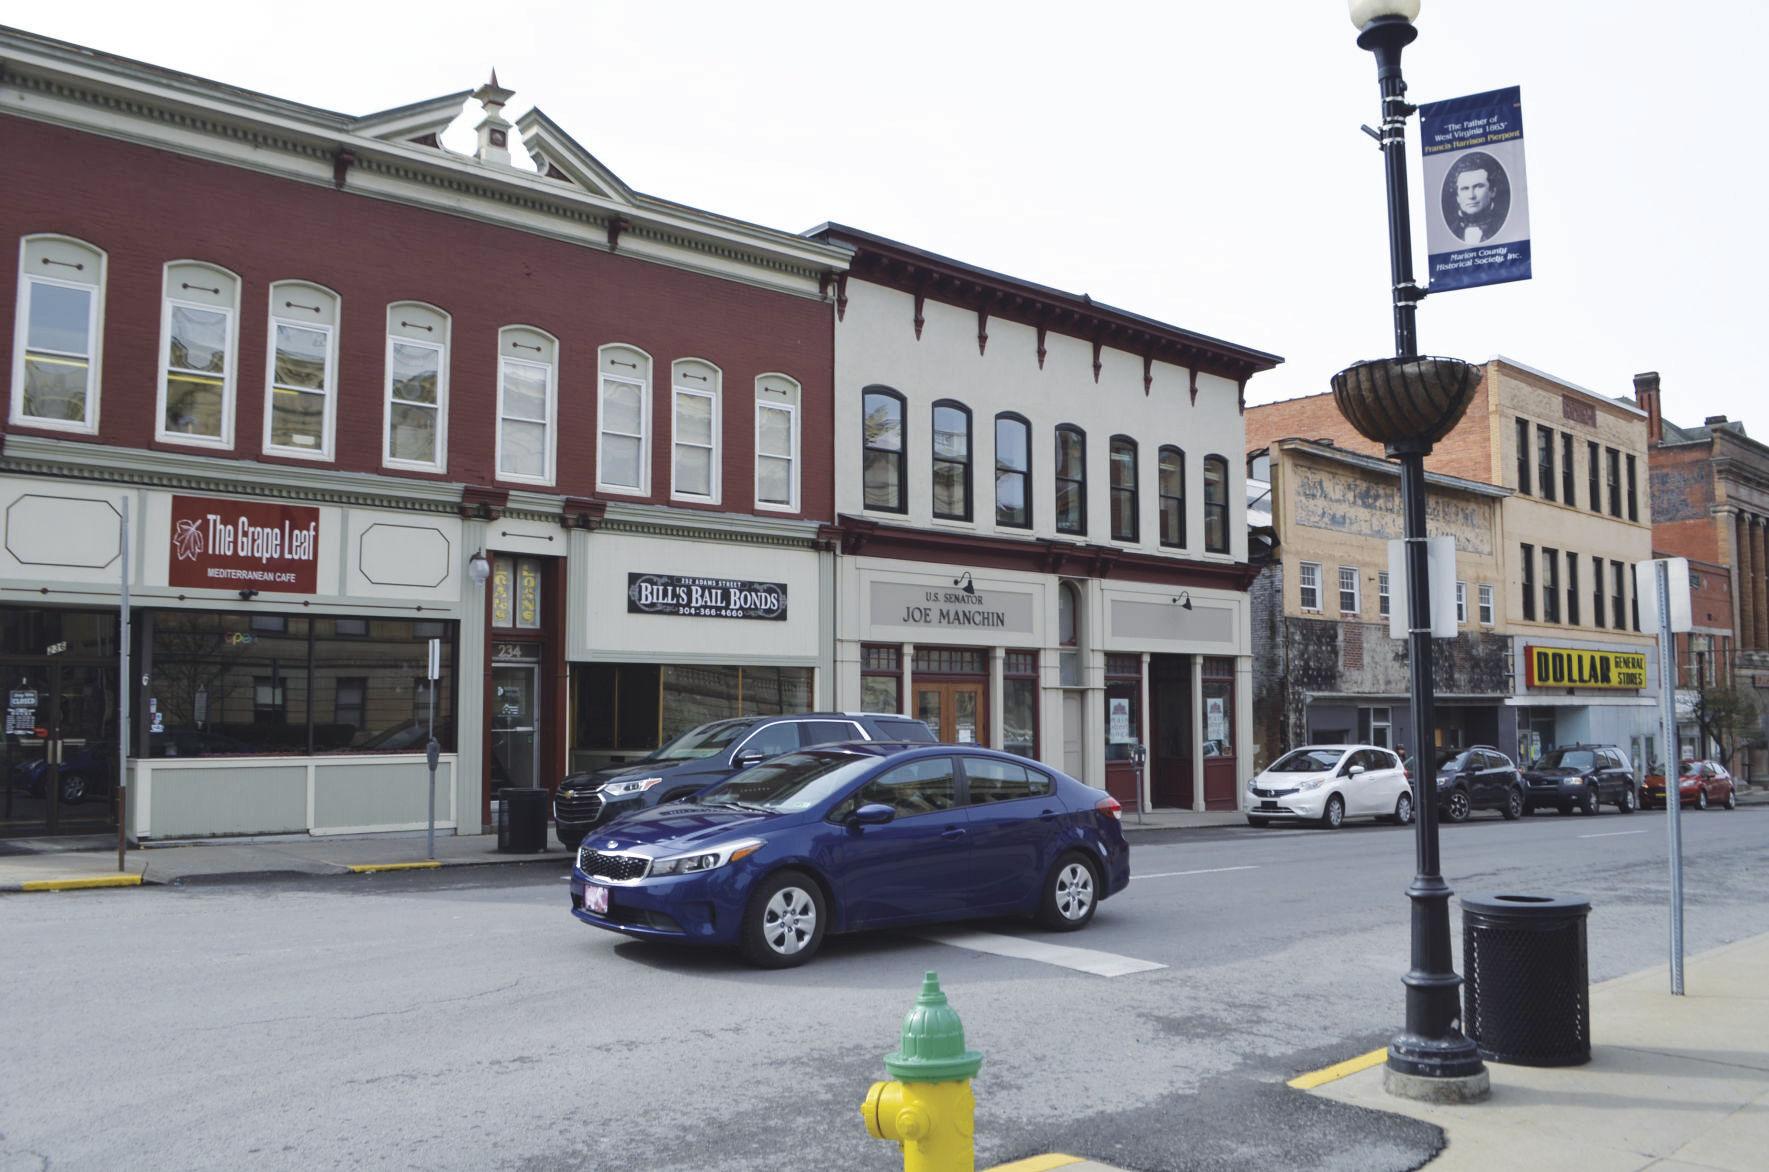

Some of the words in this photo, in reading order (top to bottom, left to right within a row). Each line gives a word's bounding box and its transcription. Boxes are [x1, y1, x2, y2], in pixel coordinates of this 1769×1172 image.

[1463, 118, 1487, 129] Father
[1489, 115, 1498, 123] of
[1424, 142, 1452, 153] Francis
[1453, 136, 1486, 148] Harrison
[1487, 130, 1520, 142] Pierpont
[1434, 133, 1452, 142] West
[1454, 126, 1483, 138] Virginia
[1436, 258, 1473, 272] Historical
[1473, 254, 1505, 265] Society,
[1507, 252, 1522, 261] Inc.
[1450, 250, 1477, 261] Marion
[1478, 247, 1508, 257] County
[207, 513, 234, 556] The
[237, 516, 281, 564] Grape
[284, 519, 316, 561] Leaf
[207, 567, 274, 582] MEDITERRANEAN
[275, 572, 296, 583] CAFE
[695, 578, 717, 587] ADAMS
[718, 579, 741, 589] STREET
[639, 582, 688, 605] BILL'S
[690, 585, 726, 608] BAIL
[729, 588, 779, 610] BONDS
[925, 591, 940, 602] U.S.
[943, 592, 984, 605] SENATOR
[678, 606, 743, 618] 304-366-4660
[903, 606, 932, 624] JOE
[938, 608, 1005, 627] MANCHIN
[497, 644, 522, 658] 234
[1536, 651, 1612, 684] DOLLAR
[1614, 655, 1644, 670] GENERAL
[1617, 671, 1643, 686] STORES
